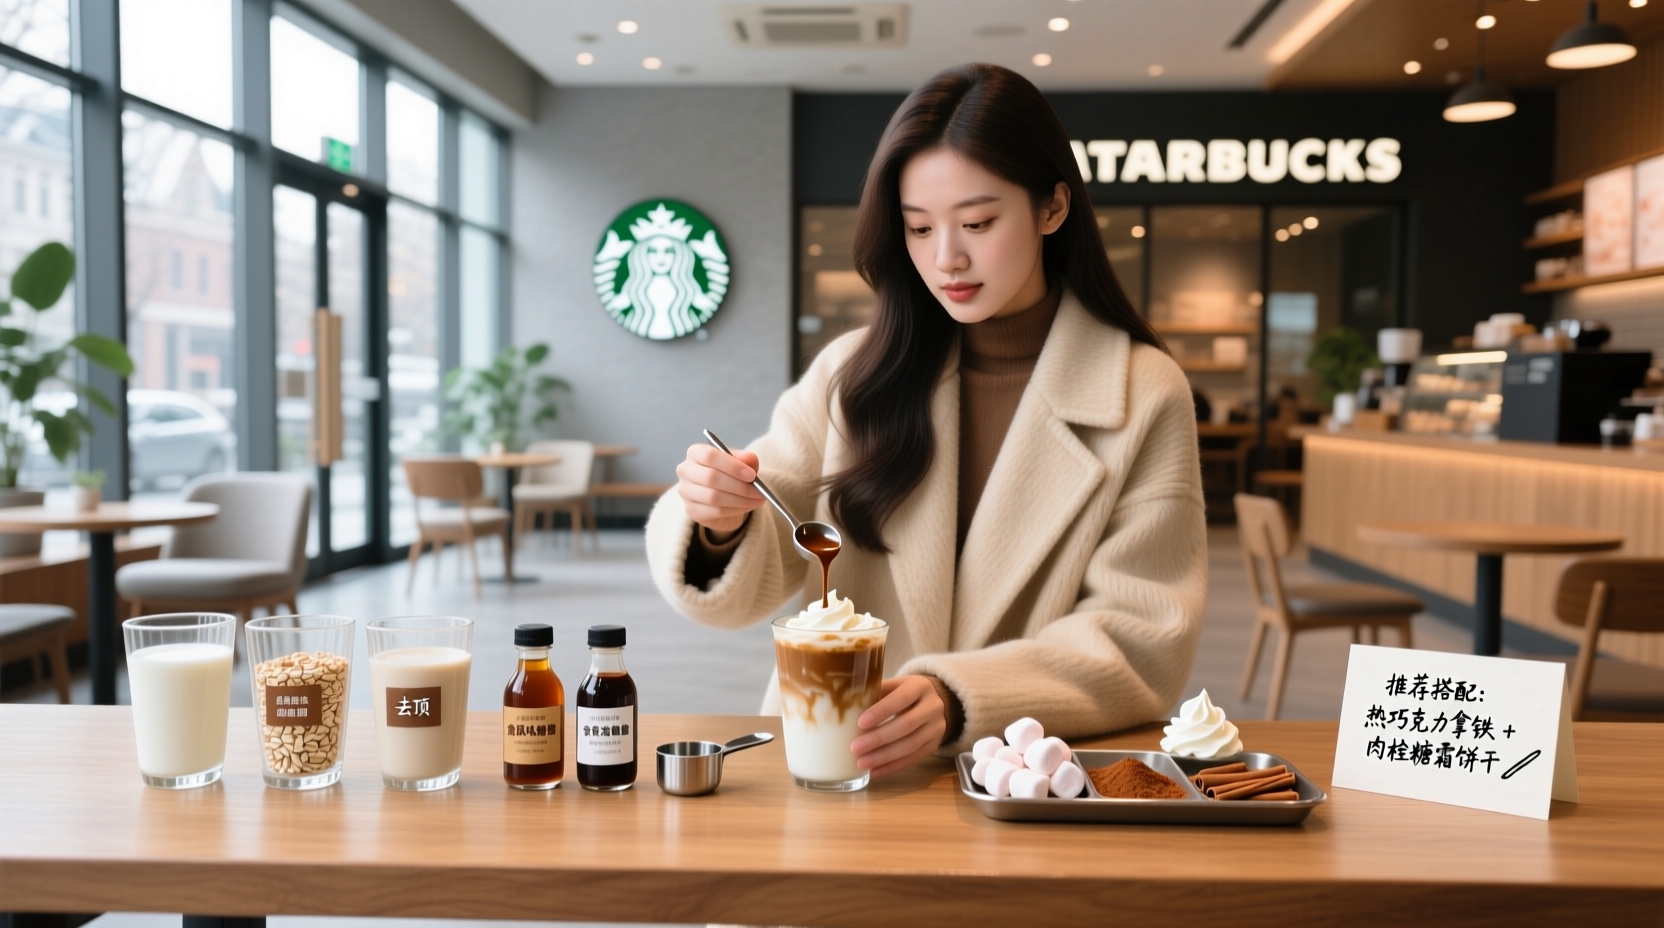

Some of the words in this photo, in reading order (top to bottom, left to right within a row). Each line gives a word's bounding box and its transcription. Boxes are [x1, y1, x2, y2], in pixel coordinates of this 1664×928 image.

[394, 695, 430, 717] 去顶
[1364, 704, 1496, 741] 热巧克力拿铁
